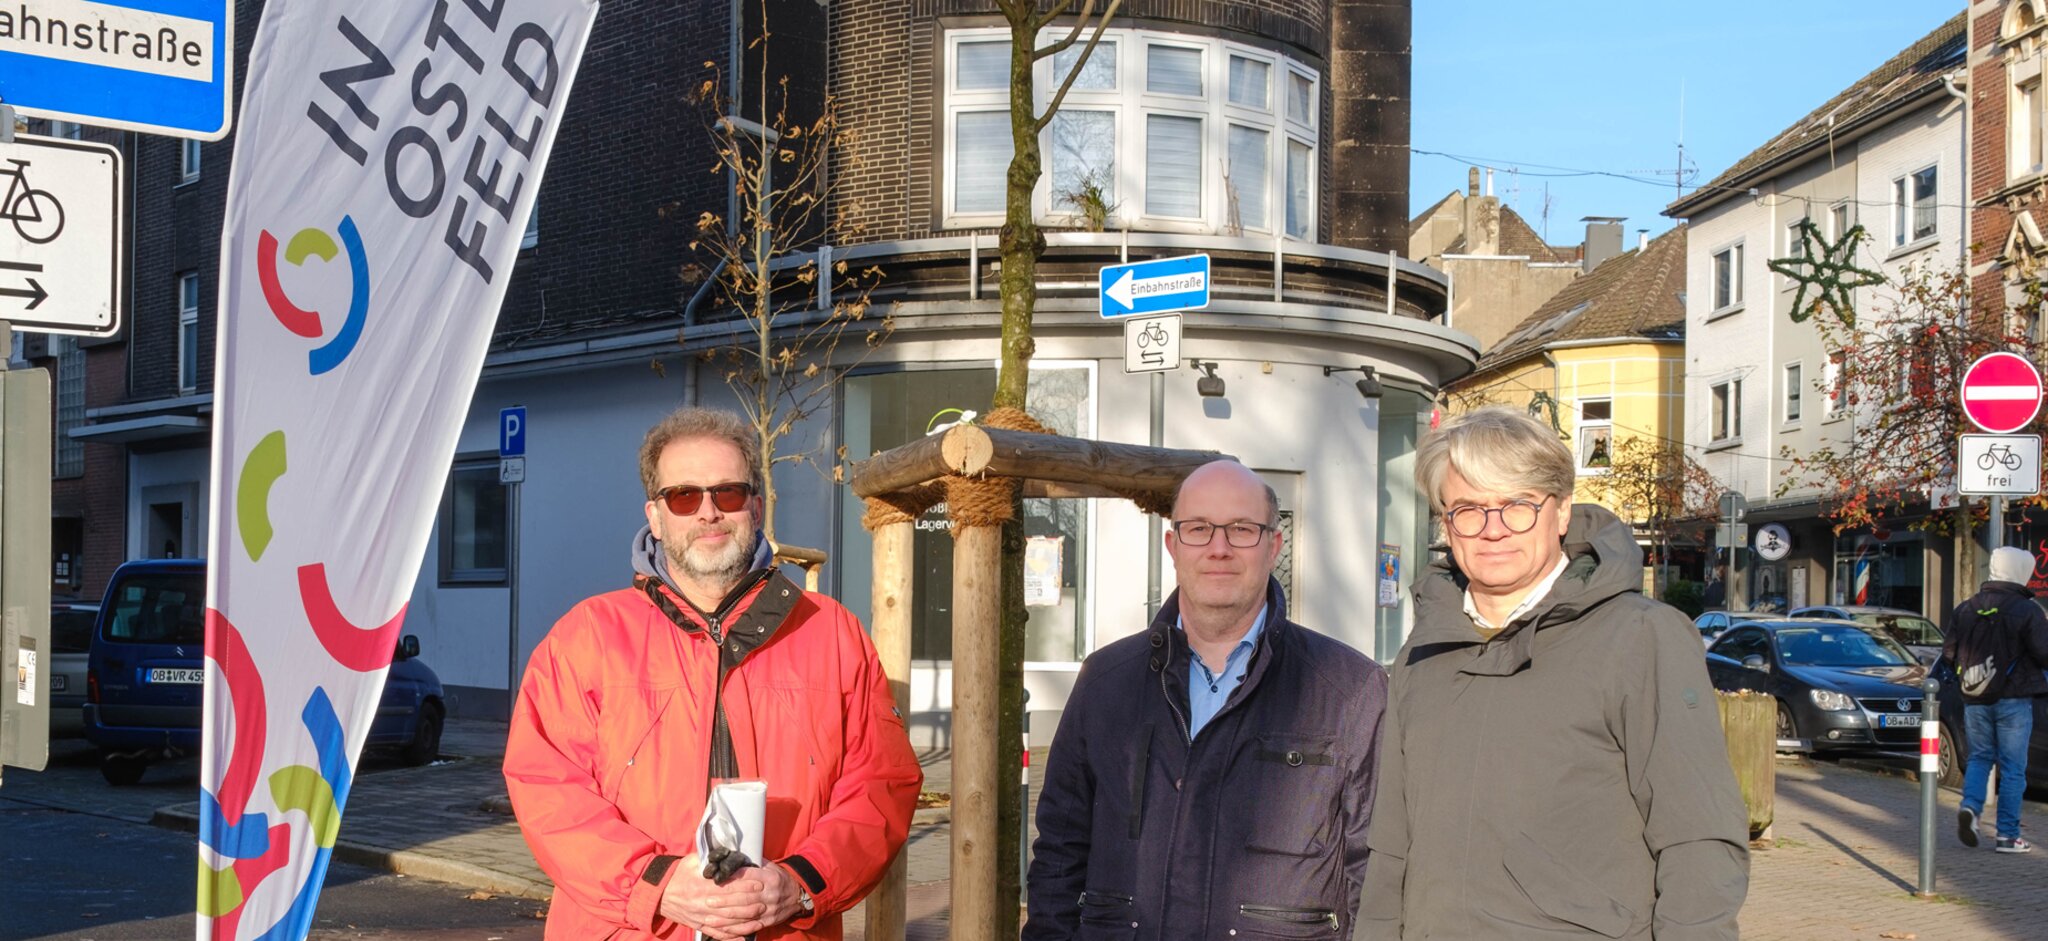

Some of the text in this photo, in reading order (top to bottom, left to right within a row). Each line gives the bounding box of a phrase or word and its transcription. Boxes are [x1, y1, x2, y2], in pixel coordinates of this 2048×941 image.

[0, 4, 202, 67] ahnstraße
[307, 15, 395, 166] IN
[444, 22, 559, 284] FELD
[1130, 276, 1202, 295] Einbahnstraße
[505, 414, 520, 450] P
[1987, 474, 2012, 487] frei
[915, 519, 955, 532] Lagerv
[152, 670, 165, 681] OB
[173, 670, 186, 681] VR
